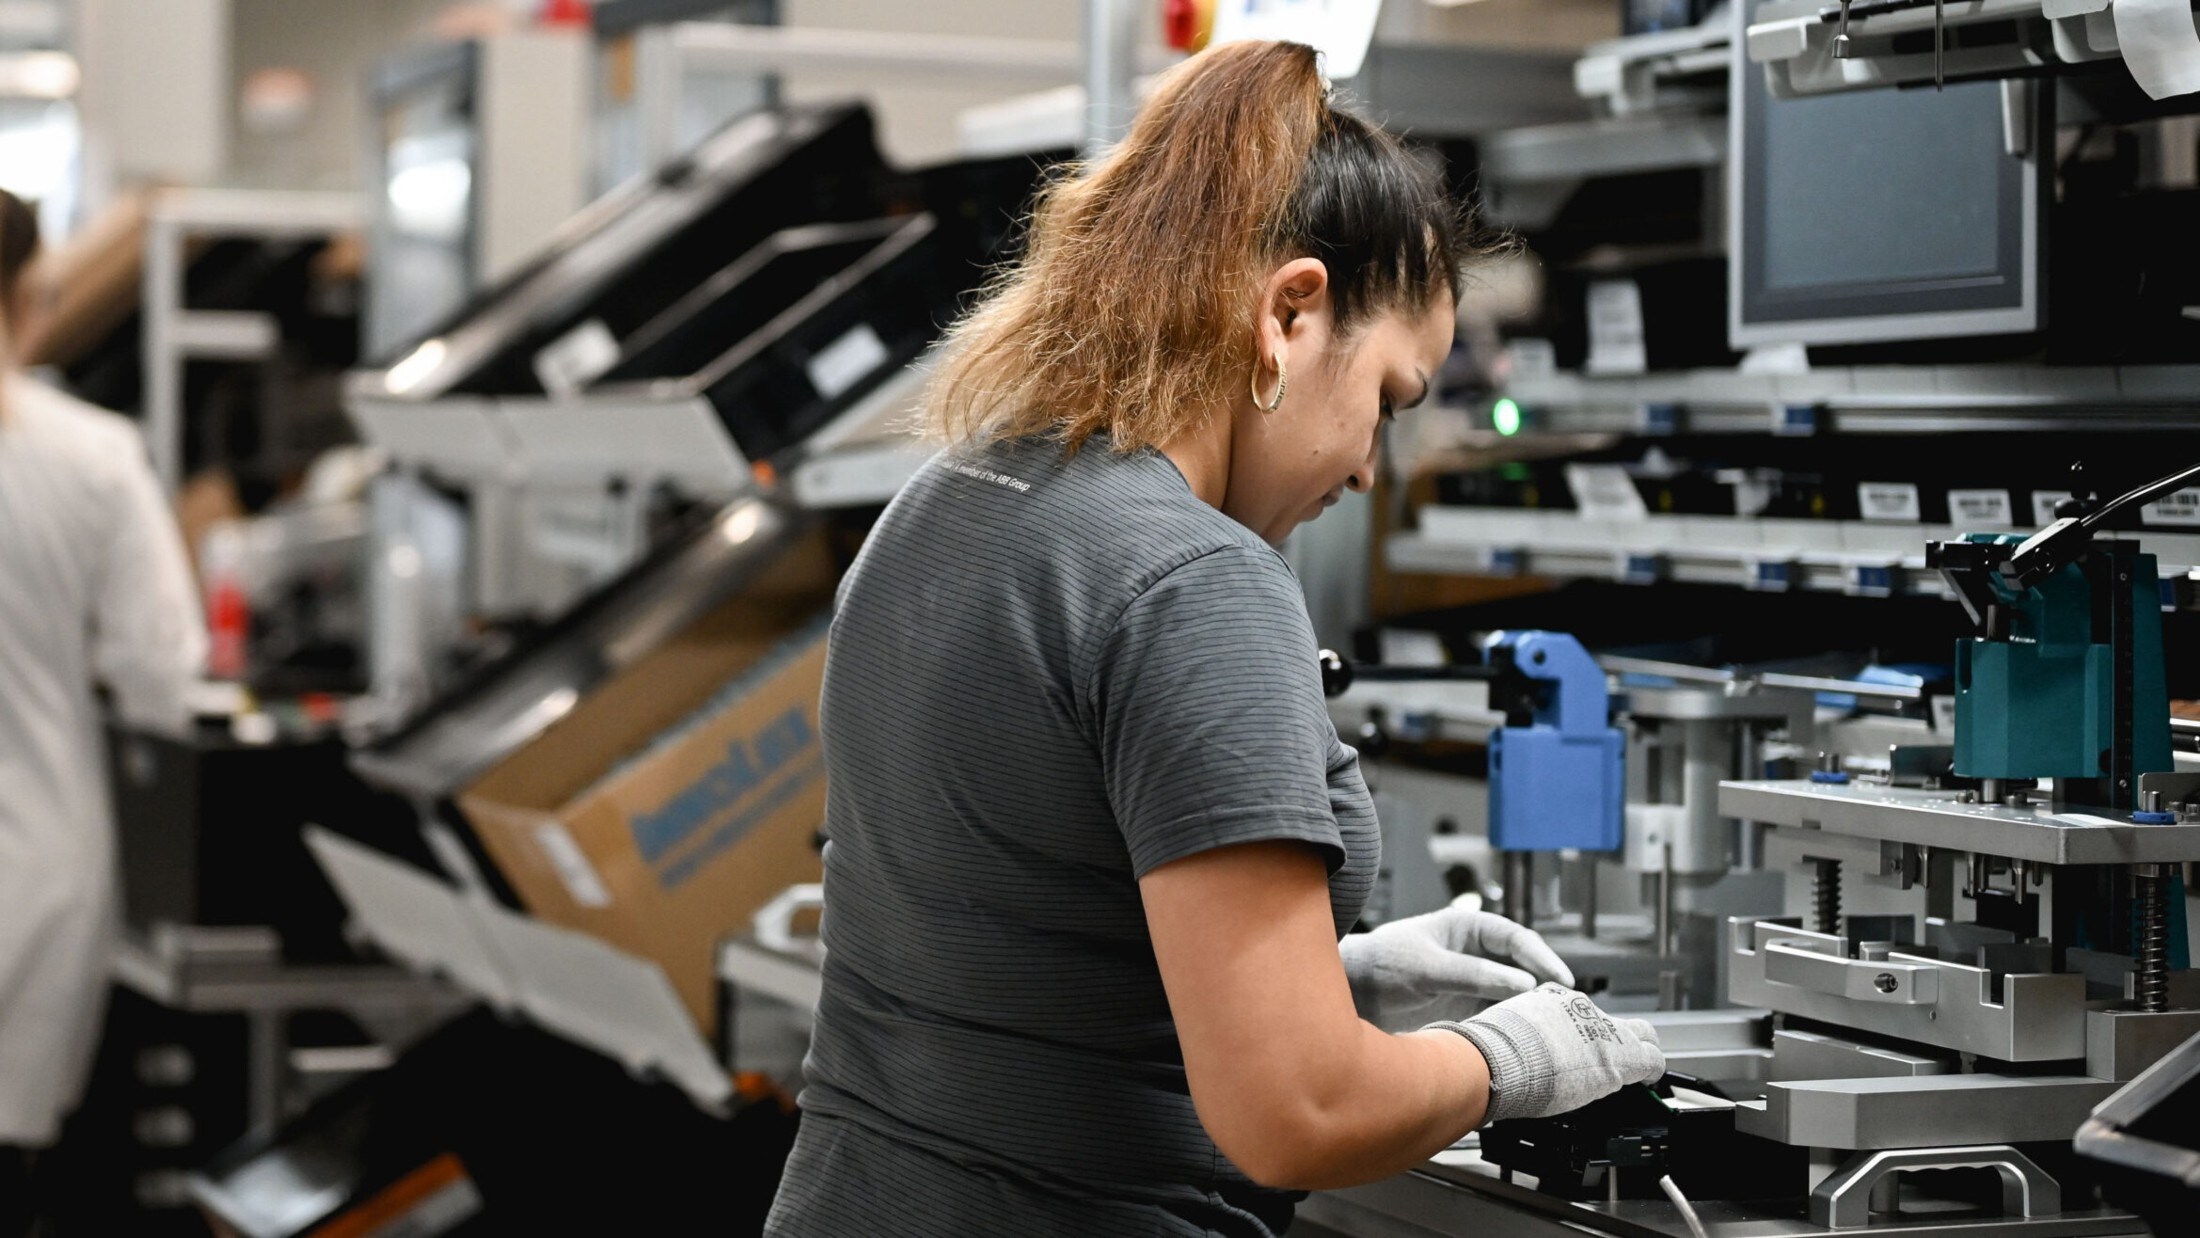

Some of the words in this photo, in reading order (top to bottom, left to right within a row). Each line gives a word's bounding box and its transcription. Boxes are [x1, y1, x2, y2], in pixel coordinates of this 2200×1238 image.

[960, 465, 982, 478] member
[986, 471, 998, 482] the
[996, 474, 1011, 485] ABB
[1008, 478, 1031, 492] Group
[1589, 1025, 1599, 1038] LOT
